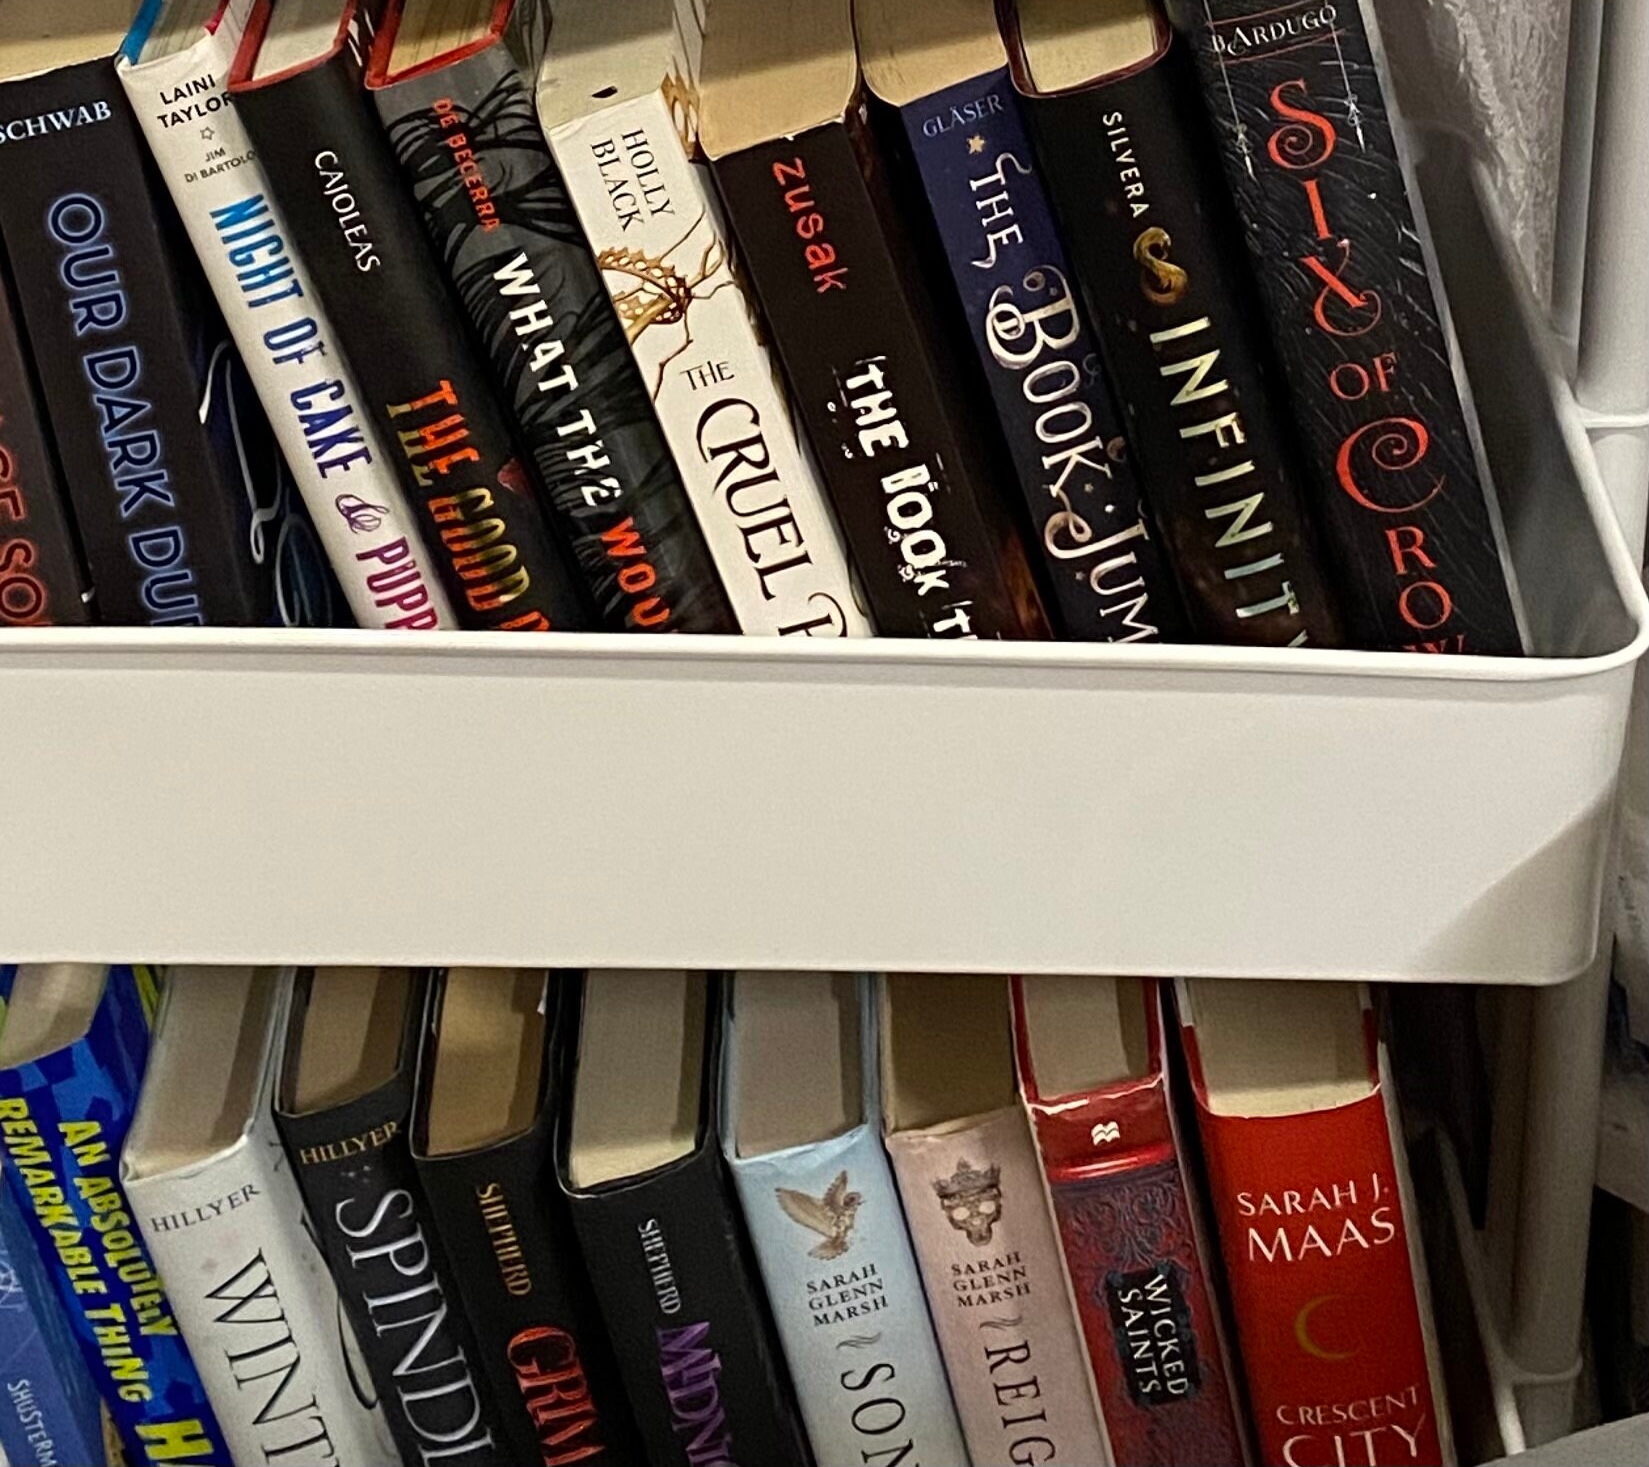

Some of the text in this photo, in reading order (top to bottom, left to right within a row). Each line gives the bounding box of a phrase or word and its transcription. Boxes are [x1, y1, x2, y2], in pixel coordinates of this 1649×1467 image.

[1211, 3, 1338, 57] BARDUGO
[157, 90, 234, 129] TAYLOR
[159, 73, 217, 106] LAINI
[184, 150, 257, 184] DI BARTOLO
[203, 146, 227, 163] JIM
[431, 95, 501, 232] DE BECERRA
[590, 138, 645, 233] BLACK
[621, 128, 676, 218] HOLLY
[1101, 110, 1150, 219] SILVERA
[209, 192, 305, 310] NIGHT
[313, 149, 383, 274] CAJOLEAS
[968, 152, 1033, 269] THE
[1266, 78, 1383, 337] SIX
[48, 193, 129, 337] OUR
[262, 316, 328, 366] OF
[493, 251, 579, 393] WHAT
[556, 409, 624, 508] THE
[678, 360, 736, 392] THE
[985, 264, 1112, 497] BOOK
[1328, 351, 1398, 401] OF
[83, 344, 176, 519] DARK
[288, 376, 374, 480] CAKE
[386, 379, 481, 487] THE
[694, 396, 813, 603] CRUEL
[845, 363, 910, 457] THE
[880, 462, 951, 597] BOOK
[1149, 315, 1307, 646] INFINIT
[1336, 416, 1465, 654] CRO
[299, 1120, 400, 1166] HILLYER
[58, 1120, 180, 1336] AN ABSOLUTELY
[150, 1182, 262, 1235] HILLYER
[476, 1181, 533, 1297] SHEPHERD
[1236, 1180, 1358, 1218] SARAH
[1247, 1206, 1397, 1264] MAAS
[0, 1097, 154, 1403] REMARKABLE THING
[637, 1218, 682, 1315] SHEPHERD
[805, 1263, 878, 1296] SARAH
[808, 1277, 885, 1312] GLENN
[950, 1250, 1022, 1277] SARAH
[952, 1265, 1028, 1293] GLENN
[956, 1282, 1033, 1308] MARSH
[205, 1246, 340, 1467] WINT
[813, 1295, 889, 1327] MARSH
[1117, 1287, 1163, 1395] SAINTS
[1143, 1273, 1190, 1396] WICKED
[1275, 1383, 1421, 1427] CRESCENT
[1281, 1411, 1427, 1467] CITY
